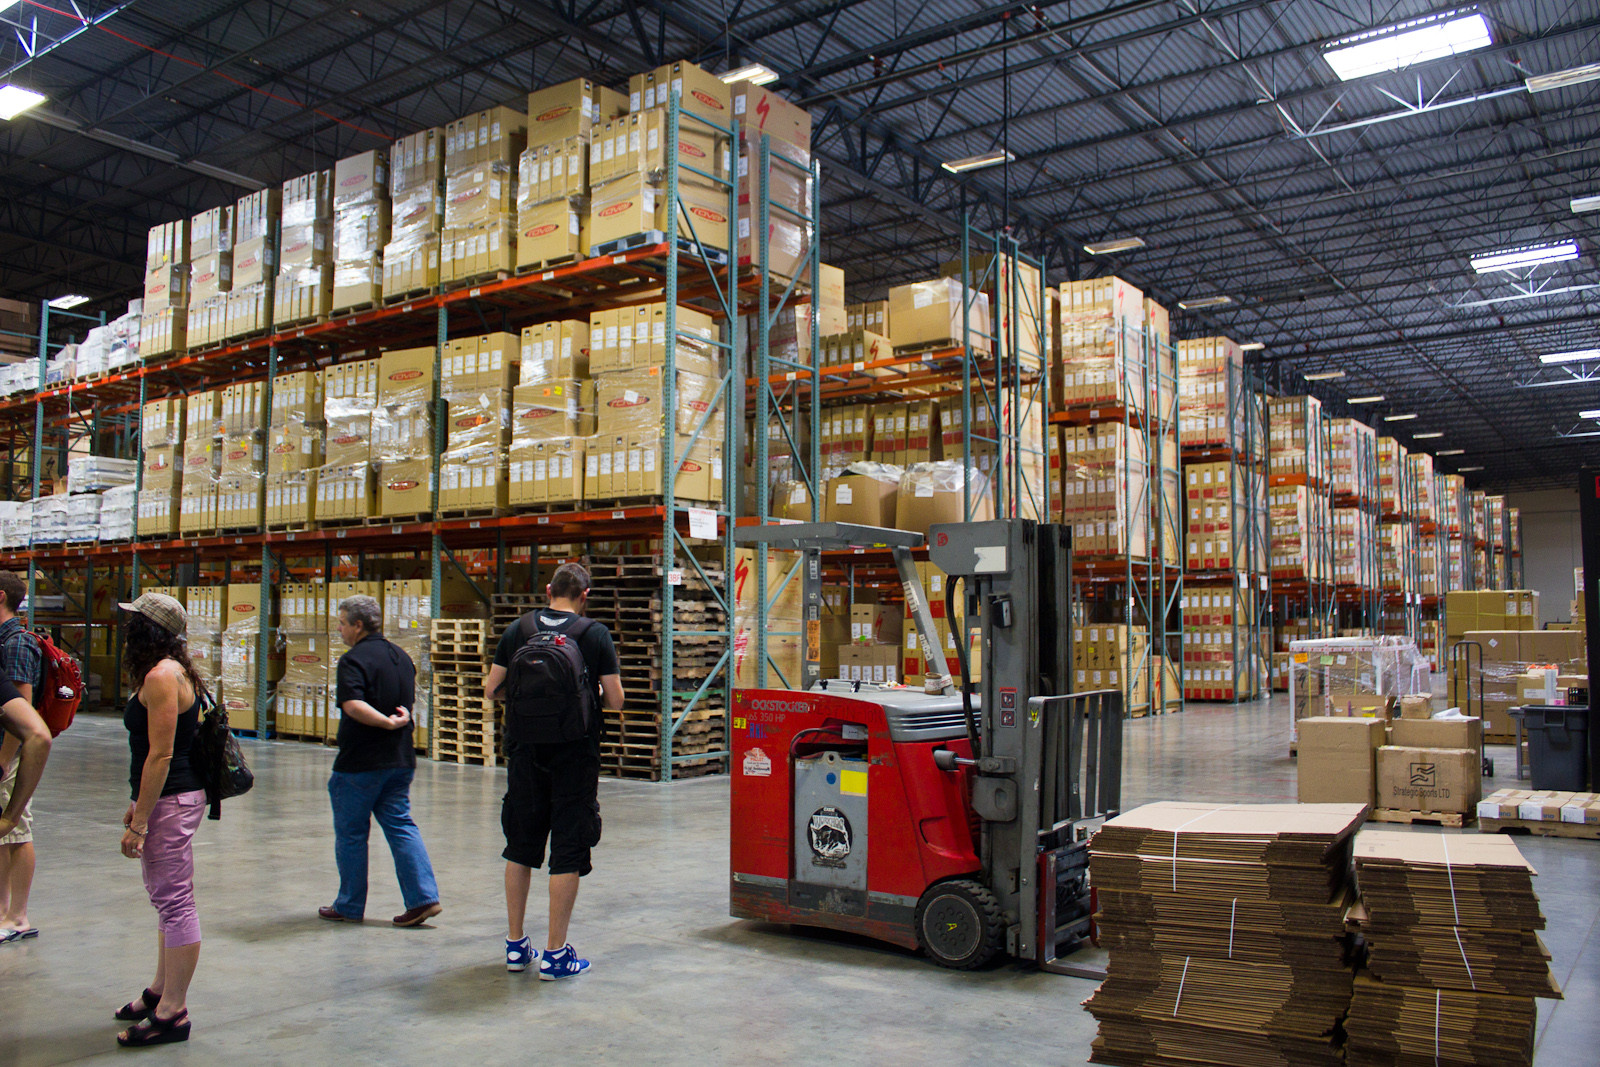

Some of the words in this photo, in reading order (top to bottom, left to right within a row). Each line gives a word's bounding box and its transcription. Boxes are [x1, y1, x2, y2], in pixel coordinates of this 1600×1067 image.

[760, 713, 773, 723] 350
[1393, 785, 1418, 799] Strategic
[1419, 787, 1437, 799] Sports
[1438, 788, 1450, 798] LTD
